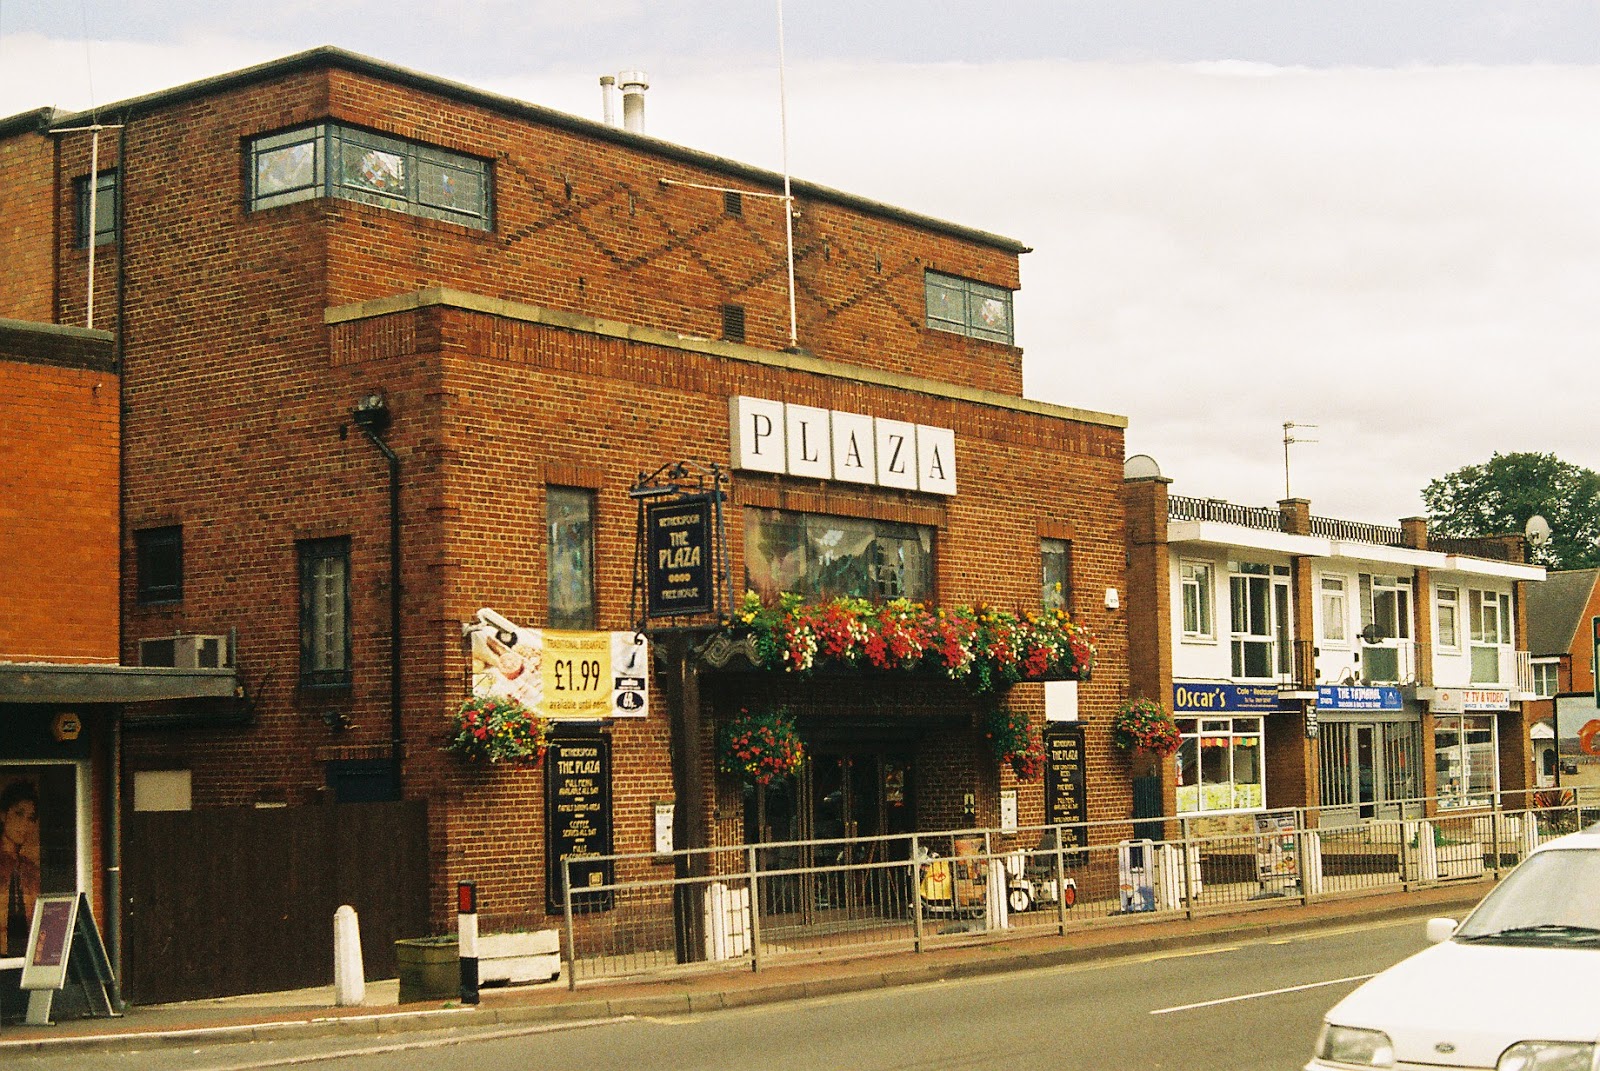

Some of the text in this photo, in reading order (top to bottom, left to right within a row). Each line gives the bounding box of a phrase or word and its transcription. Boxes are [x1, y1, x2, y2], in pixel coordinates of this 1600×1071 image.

[750, 412, 947, 481] PLAZA
[669, 531, 689, 547] THE
[658, 546, 700, 569] PLAZA
[555, 659, 600, 691] £1.99
[1176, 687, 1226, 708] Oscar's
[1337, 687, 1350, 699] THE
[1471, 691, 1480, 702] TV
[1486, 691, 1504, 703] VIDEO
[557, 760, 600, 774] THE PLAZA
